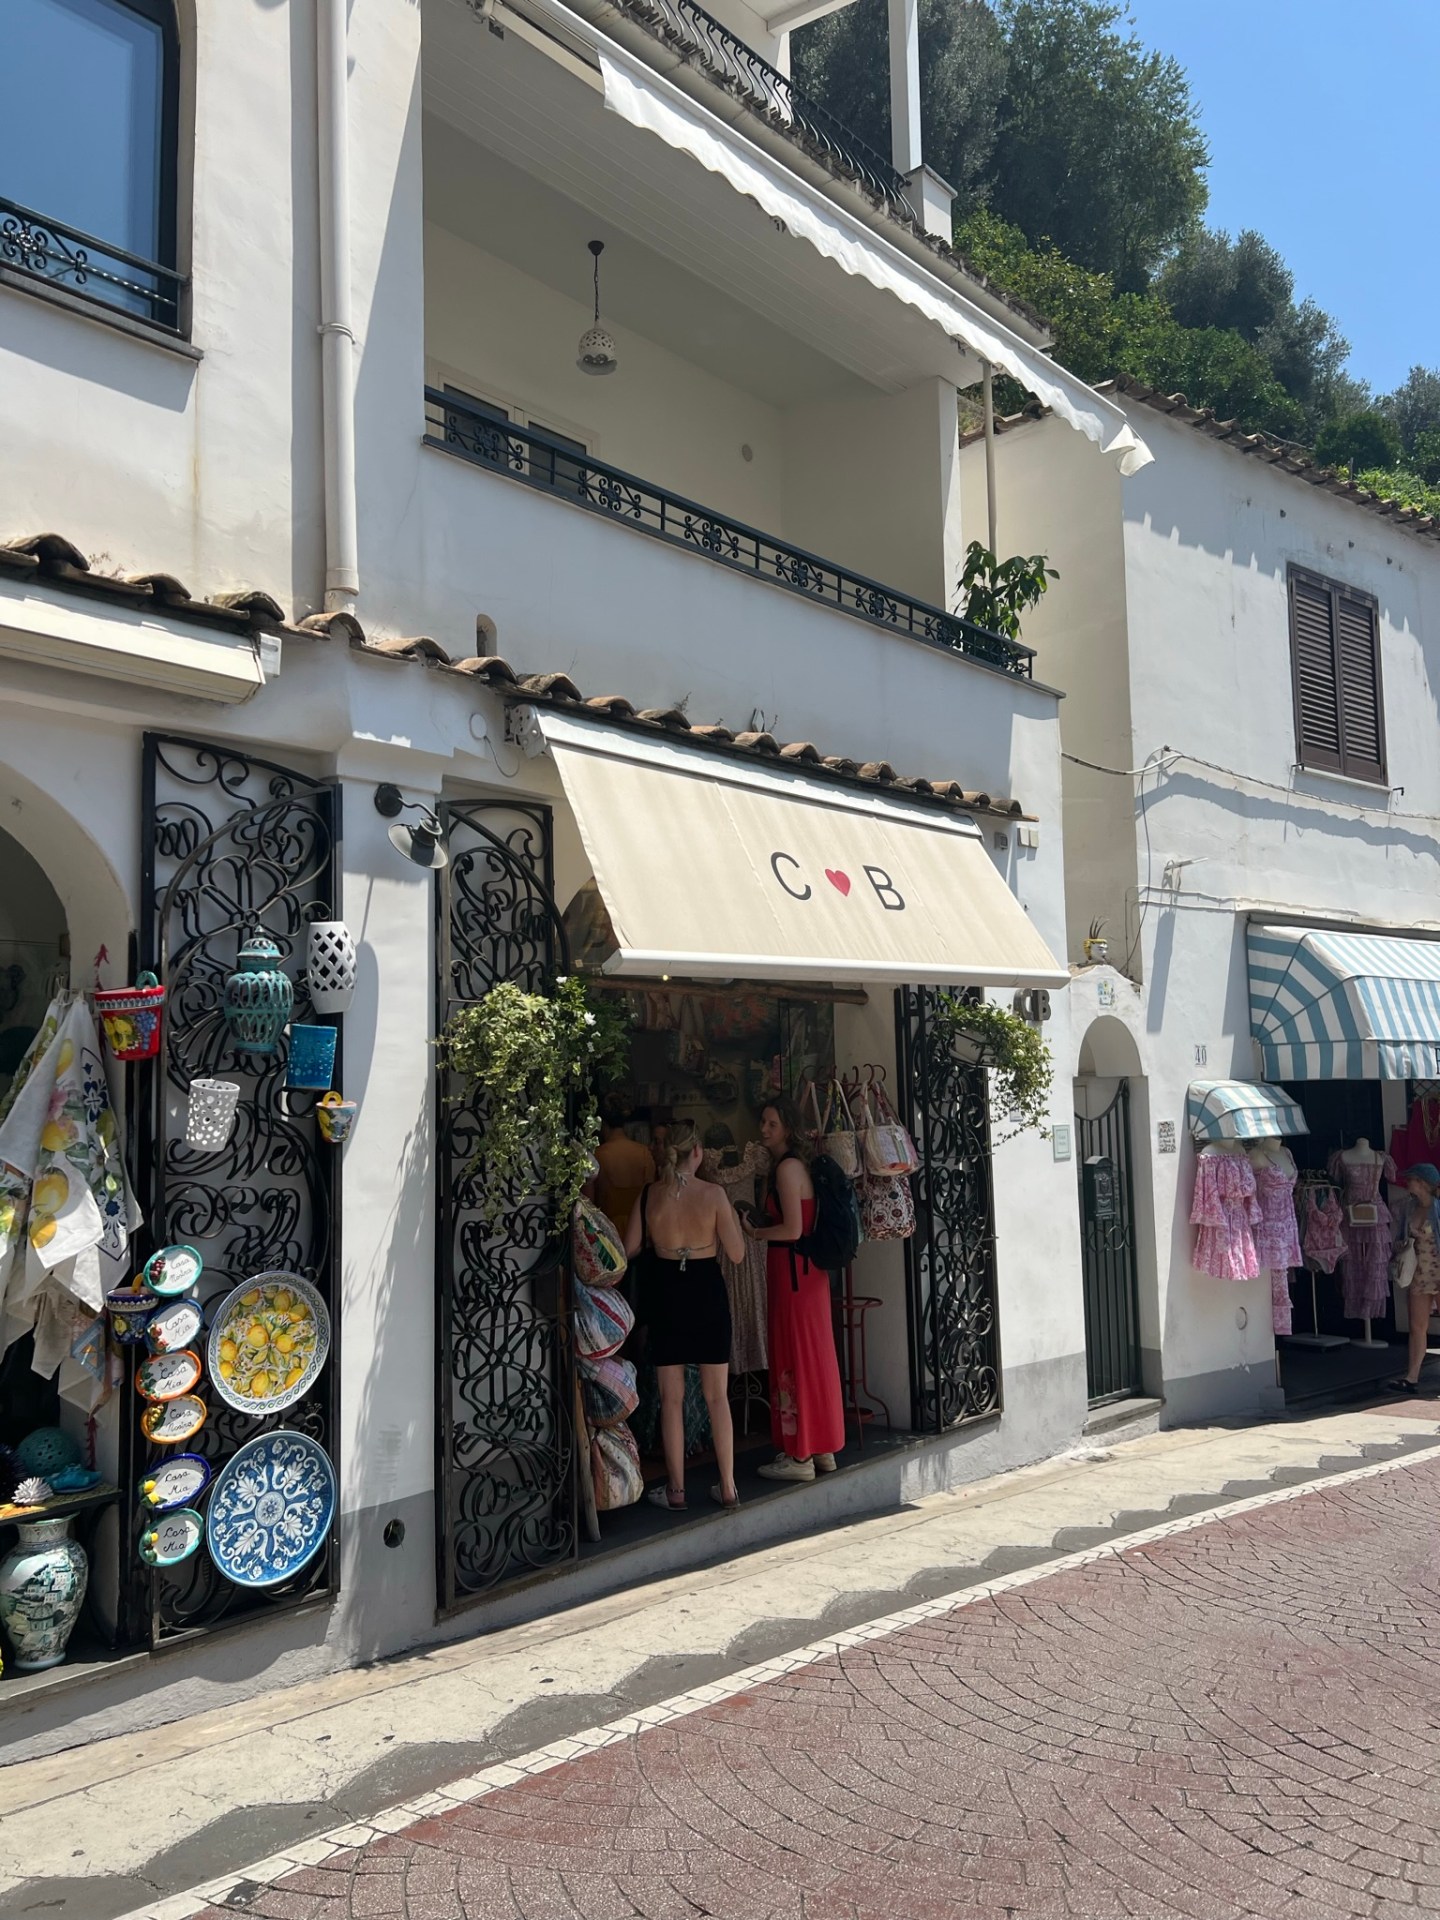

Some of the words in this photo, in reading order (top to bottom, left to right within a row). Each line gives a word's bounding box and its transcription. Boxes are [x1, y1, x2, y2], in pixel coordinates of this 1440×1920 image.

[771, 851, 812, 901] C
[862, 864, 906, 911] B
[170, 1257, 191, 1270] Casa
[165, 1312, 189, 1331] Casa
[160, 1365, 188, 1380] Casa
[162, 1380, 183, 1391] Mia
[169, 1408, 193, 1419] Casa
[164, 1471, 191, 1483] Casa
[167, 1485, 192, 1496] Mia
[163, 1526, 193, 1538] Casa
[163, 1540, 188, 1553] Mia
